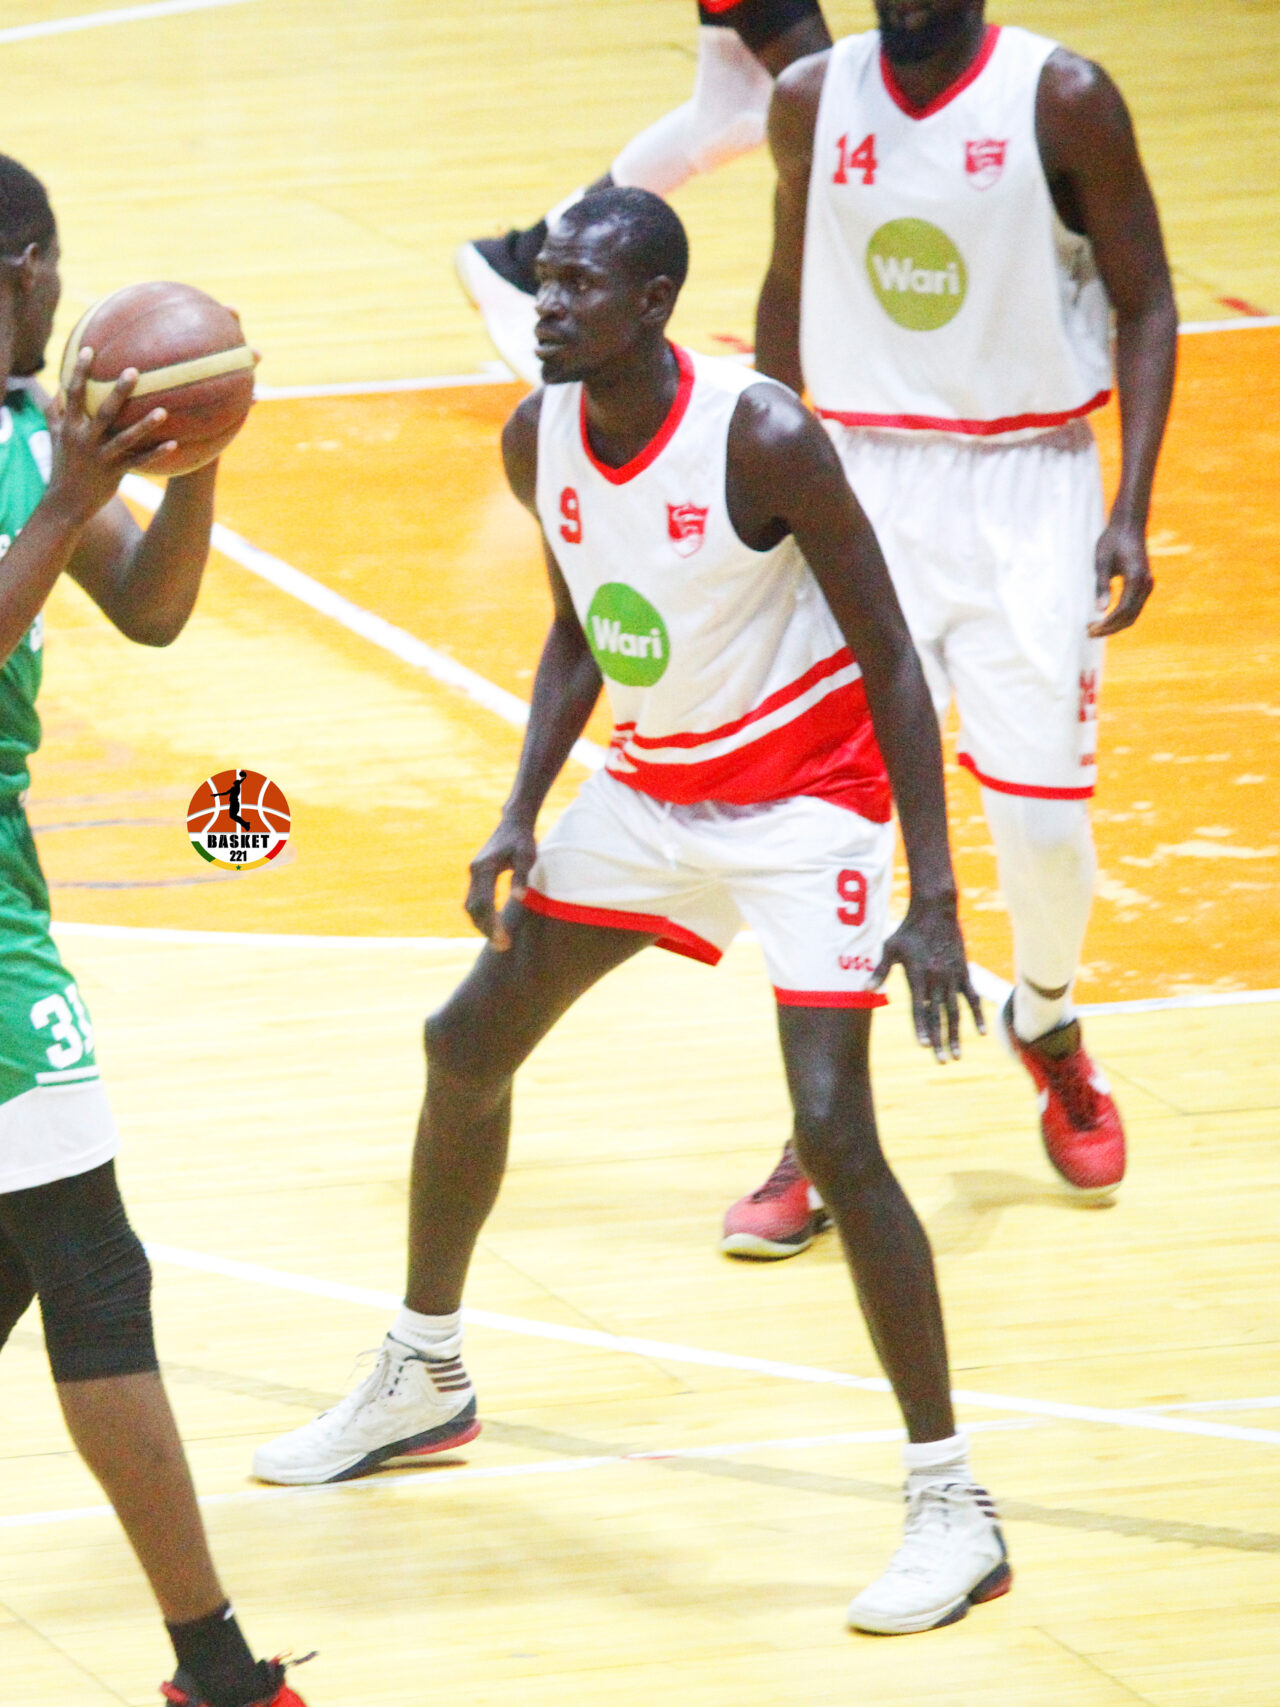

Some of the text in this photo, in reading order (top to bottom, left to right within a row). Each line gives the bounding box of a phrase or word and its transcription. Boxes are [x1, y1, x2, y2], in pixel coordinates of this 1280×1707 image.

[832, 134, 878, 185] 14
[871, 253, 961, 296] Wari
[560, 486, 584, 544] 9
[591, 614, 664, 660] Wari
[836, 869, 868, 927] 9
